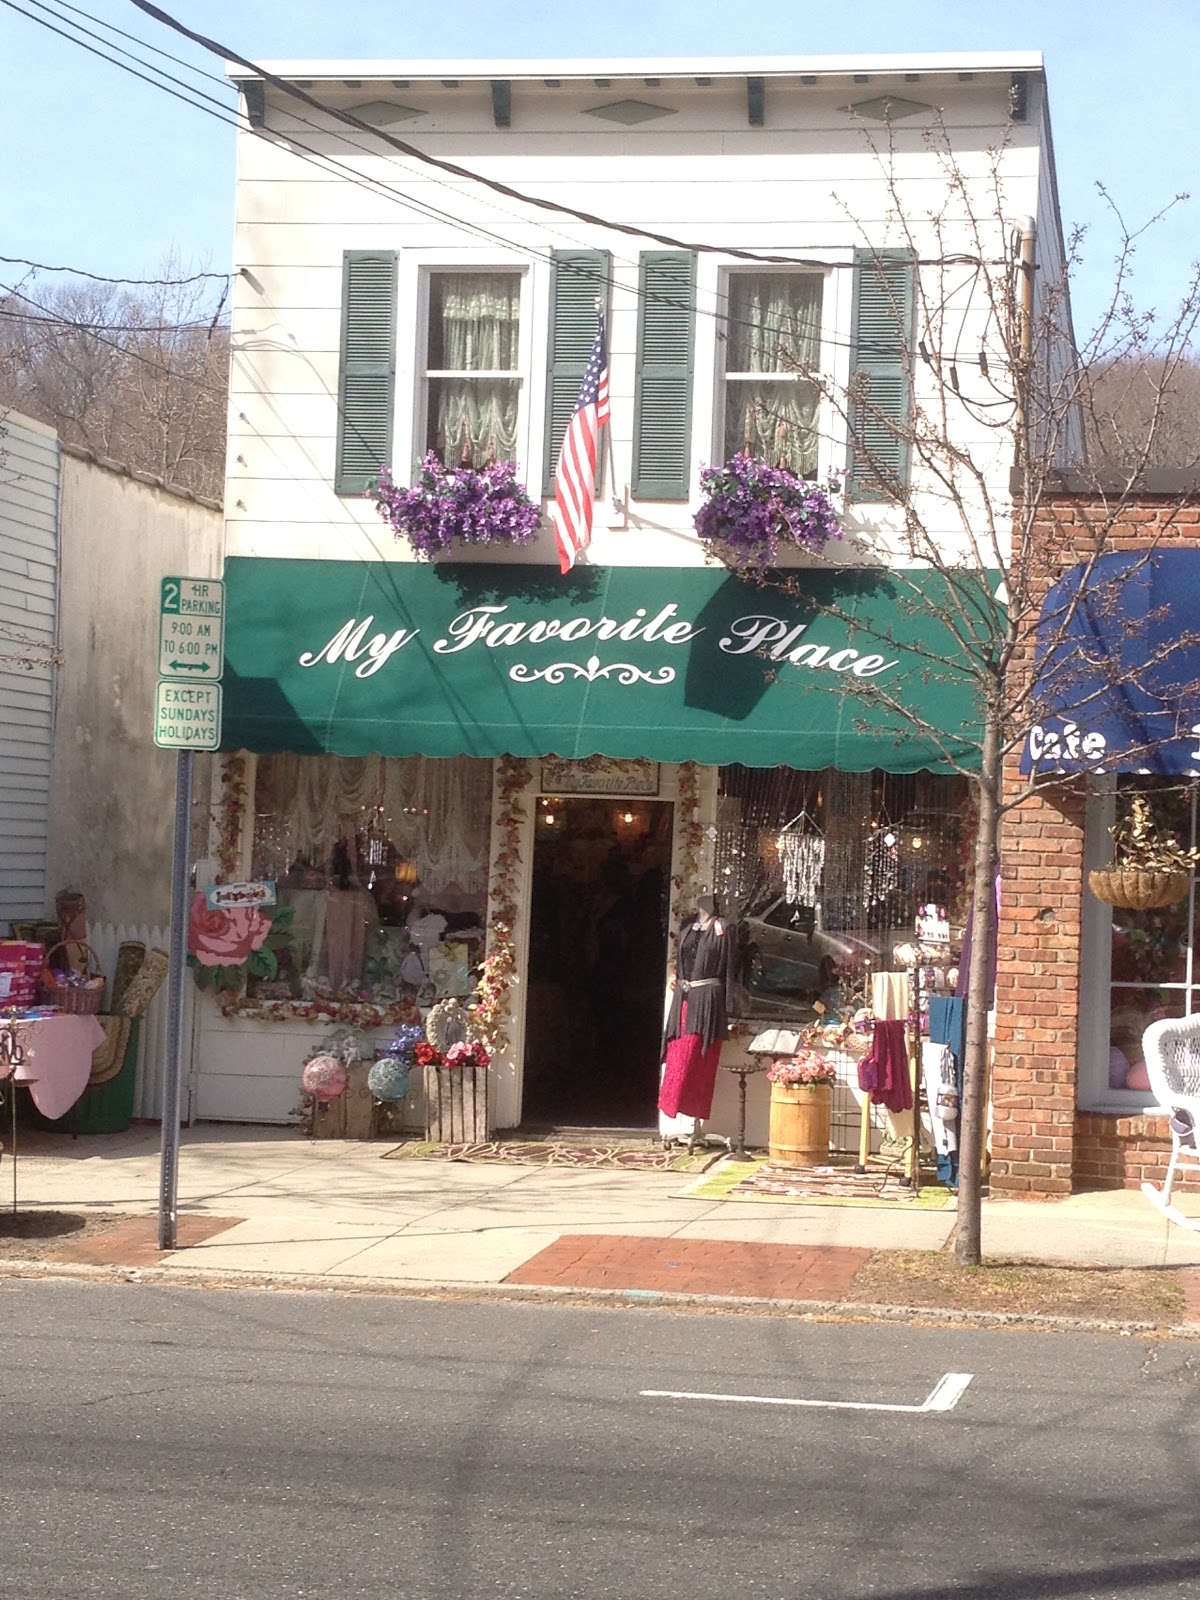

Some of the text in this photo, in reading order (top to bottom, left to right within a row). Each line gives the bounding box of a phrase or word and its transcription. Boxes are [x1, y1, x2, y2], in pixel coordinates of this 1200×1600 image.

[164, 583, 178, 609] 2
[192, 584, 209, 597] HR
[181, 599, 220, 614] PARKING
[172, 621, 211, 637] 9:00 AM
[164, 640, 218, 656] TO 6:00 PM
[299, 603, 900, 679] My Favorite Place
[165, 689, 212, 704] EXCEPT
[160, 707, 215, 722] SUNDAYS
[159, 726, 215, 740] HOLIDAYS
[1029, 724, 1107, 761] Cafe
